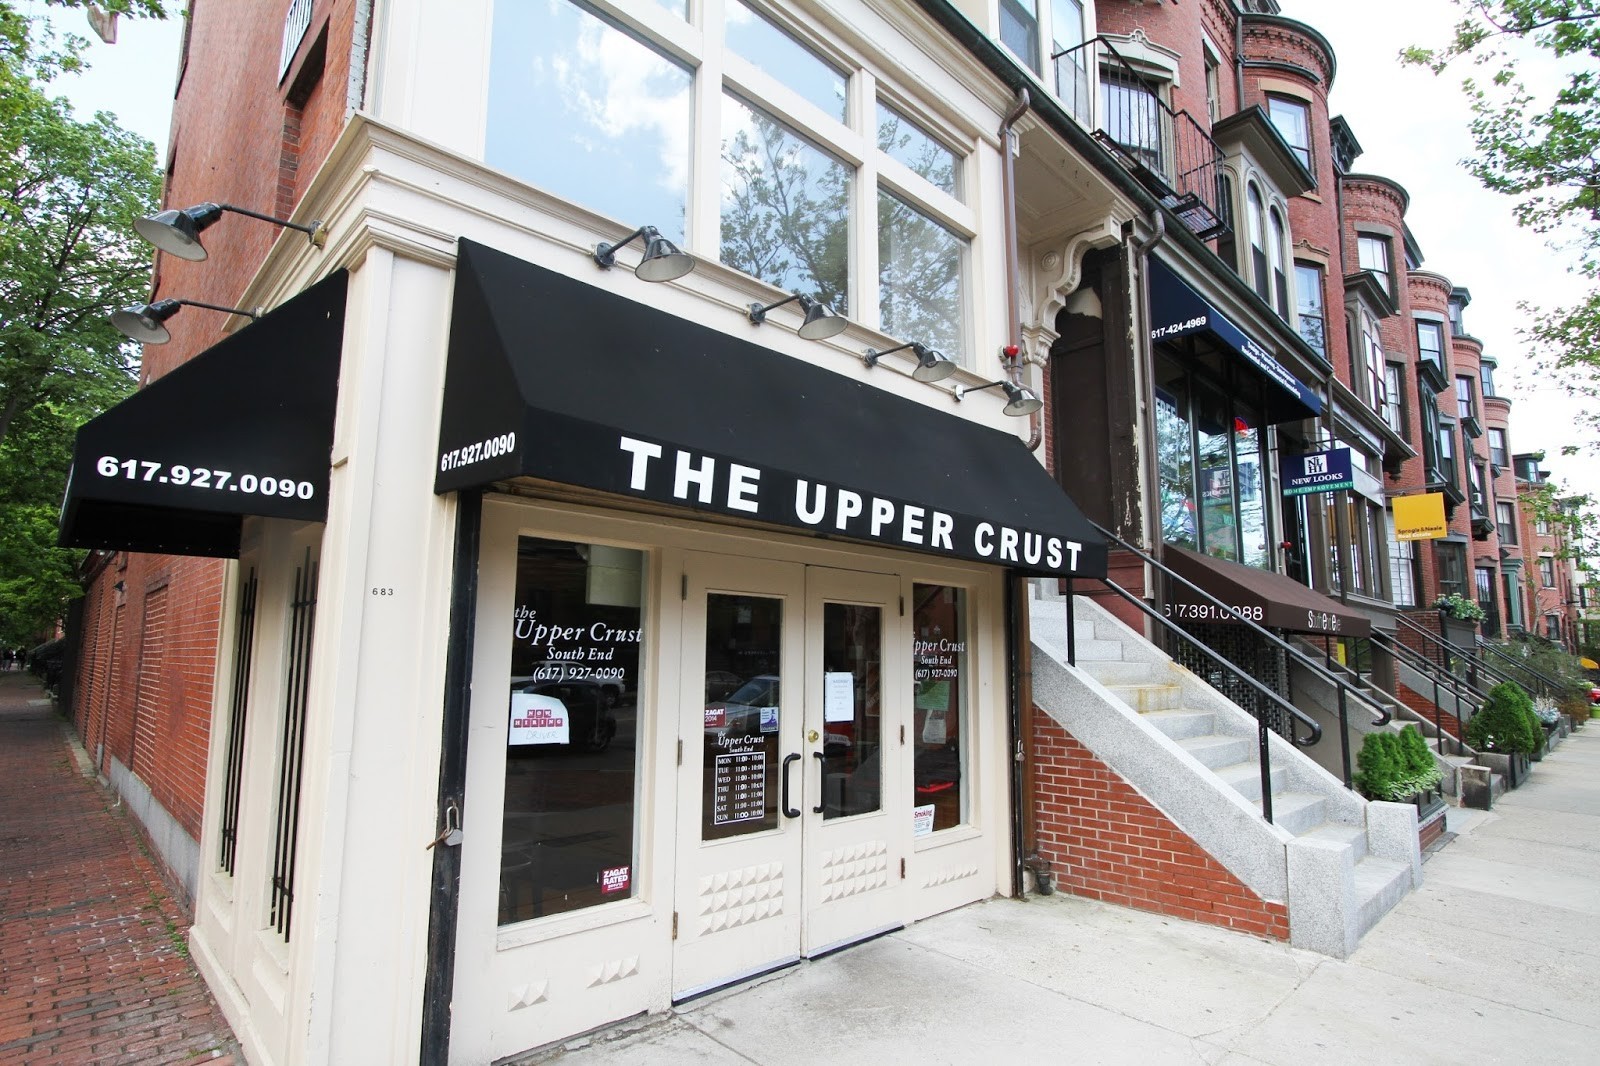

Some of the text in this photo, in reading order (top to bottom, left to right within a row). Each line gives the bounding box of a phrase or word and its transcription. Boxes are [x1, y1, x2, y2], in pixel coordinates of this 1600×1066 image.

[1151, 316, 1206, 339] 617-424-4969
[441, 431, 516, 473] 617.927.0090
[96, 455, 314, 500] 617.927.0090
[1292, 473, 1343, 485] NEW LOOKS
[1304, 481, 1353, 492] IMPROVEMENT
[620, 436, 1082, 572] THE UPPER CRUST
[372, 588, 393, 596] 683
[514, 605, 536, 619] the
[515, 619, 643, 646] Upper Crust
[913, 638, 965, 655] pper Crust
[546, 647, 614, 660] South End
[921, 655, 952, 664] South End
[533, 666, 625, 683] (617) 927-0090
[915, 669, 958, 680] (617) 927-0090
[527, 709, 551, 717] NOW
[705, 708, 724, 716] ZAGAT
[718, 735, 765, 748] Upper Crust
[913, 809, 932, 818] Smoking
[603, 867, 629, 878] ZAGAT
[603, 875, 628, 885] RATED
